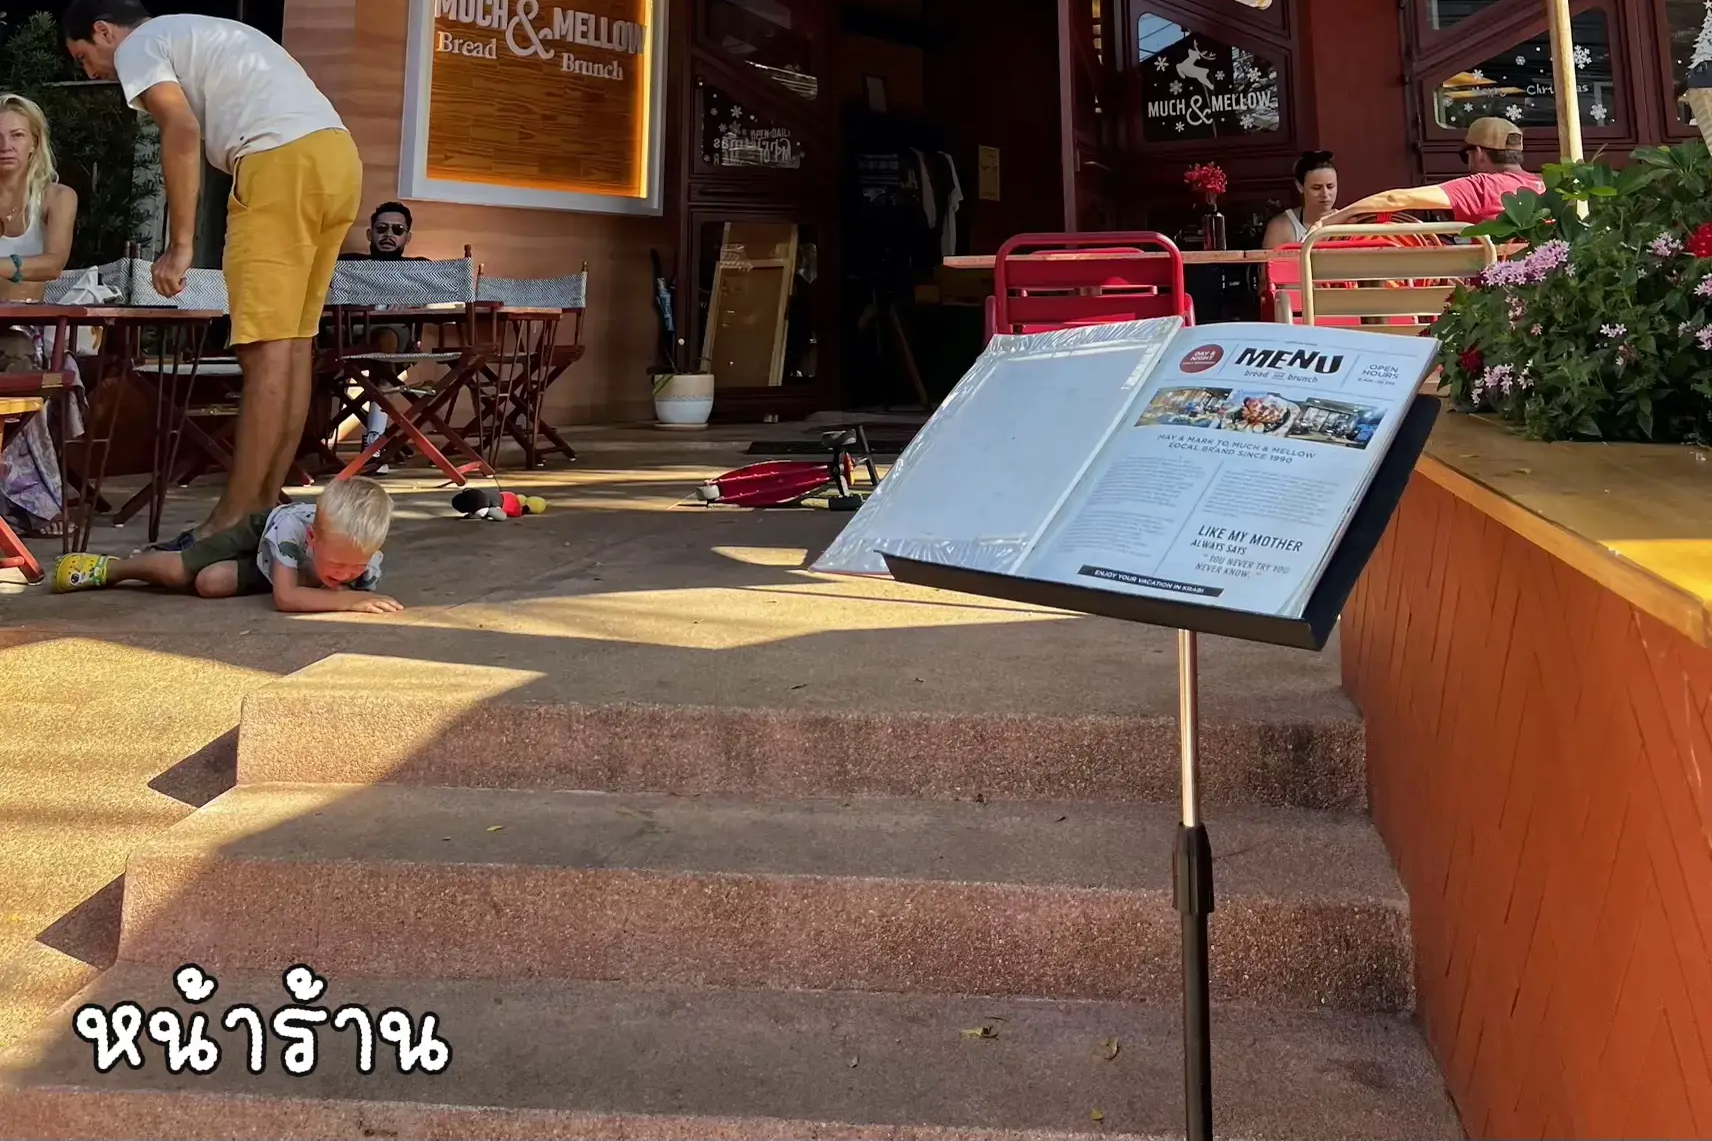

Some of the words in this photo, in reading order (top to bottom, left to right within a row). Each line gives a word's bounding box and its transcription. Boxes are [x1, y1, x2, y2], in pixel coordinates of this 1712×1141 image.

[552, 7, 648, 56] MELLOW
[437, 30, 498, 59] Bread
[560, 52, 624, 81] Brunch
[1148, 98, 1186, 118] MUCH
[1186, 95, 1214, 126] &
[1211, 90, 1273, 113] MELLOW
[1235, 347, 1344, 374] MENU
[1369, 364, 1399, 373] OPEN
[1244, 369, 1268, 378] bread
[1287, 373, 1318, 383] brunch
[1362, 369, 1399, 379] HOURS
[1168, 442, 1198, 451] LOCAL
[1201, 445, 1235, 456] BRAND
[1236, 450, 1267, 460] SINCE
[1269, 454, 1293, 464] 1990
[1187, 436, 1215, 445] MARK
[1231, 441, 1260, 452] MUCH
[1271, 446, 1316, 459] MELLOW
[1190, 538, 1225, 552] ALWAYS
[1225, 543, 1248, 556] SAYS
[1198, 525, 1226, 539] LIKE
[1227, 529, 1249, 543] MY
[1249, 533, 1304, 553] MOTHER
[1194, 562, 1223, 574] NEVER
[1226, 557, 1255, 570] NEVER
[1255, 561, 1272, 571] TRY
[1094, 569, 1117, 579] ENJOY
[1117, 574, 1138, 583] YOUR
[1138, 577, 1173, 590] VACATION
[1181, 586, 1205, 594] KRABI
